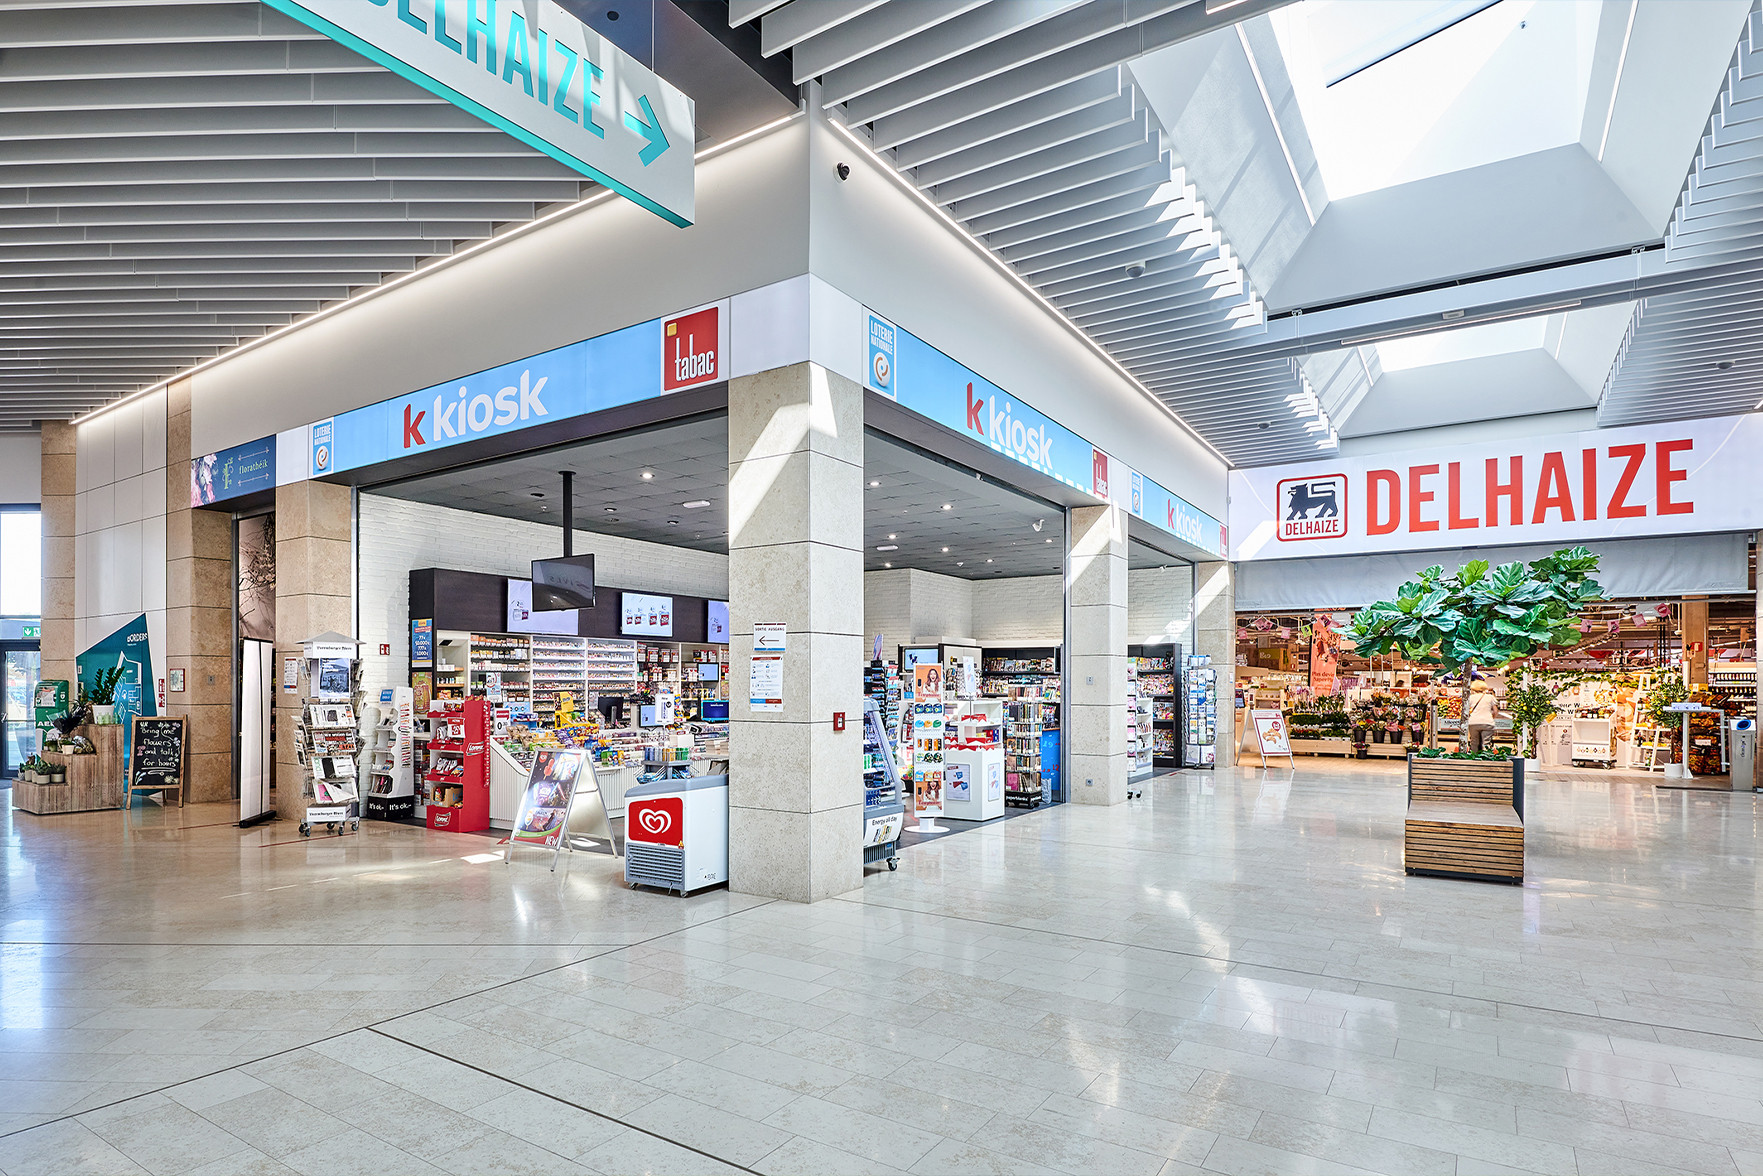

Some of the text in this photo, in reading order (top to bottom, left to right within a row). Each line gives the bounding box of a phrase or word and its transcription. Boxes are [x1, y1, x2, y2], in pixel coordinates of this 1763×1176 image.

[367, 0, 605, 140] LHAIZE
[870, 319, 893, 345] LOTERIE
[870, 334, 893, 356] NATIONALE
[674, 332, 715, 382] tabac
[403, 369, 549, 449] k kiosk
[966, 381, 1053, 469] k kiosk
[314, 424, 331, 439] LOTERIE
[1366, 438, 1694, 536] DELHAIZE
[1176, 503, 1203, 543] kiosk
[1285, 518, 1339, 536] DELHAIZE
[389, 803, 399, 811] It's
[871, 818, 886, 826] Energy
